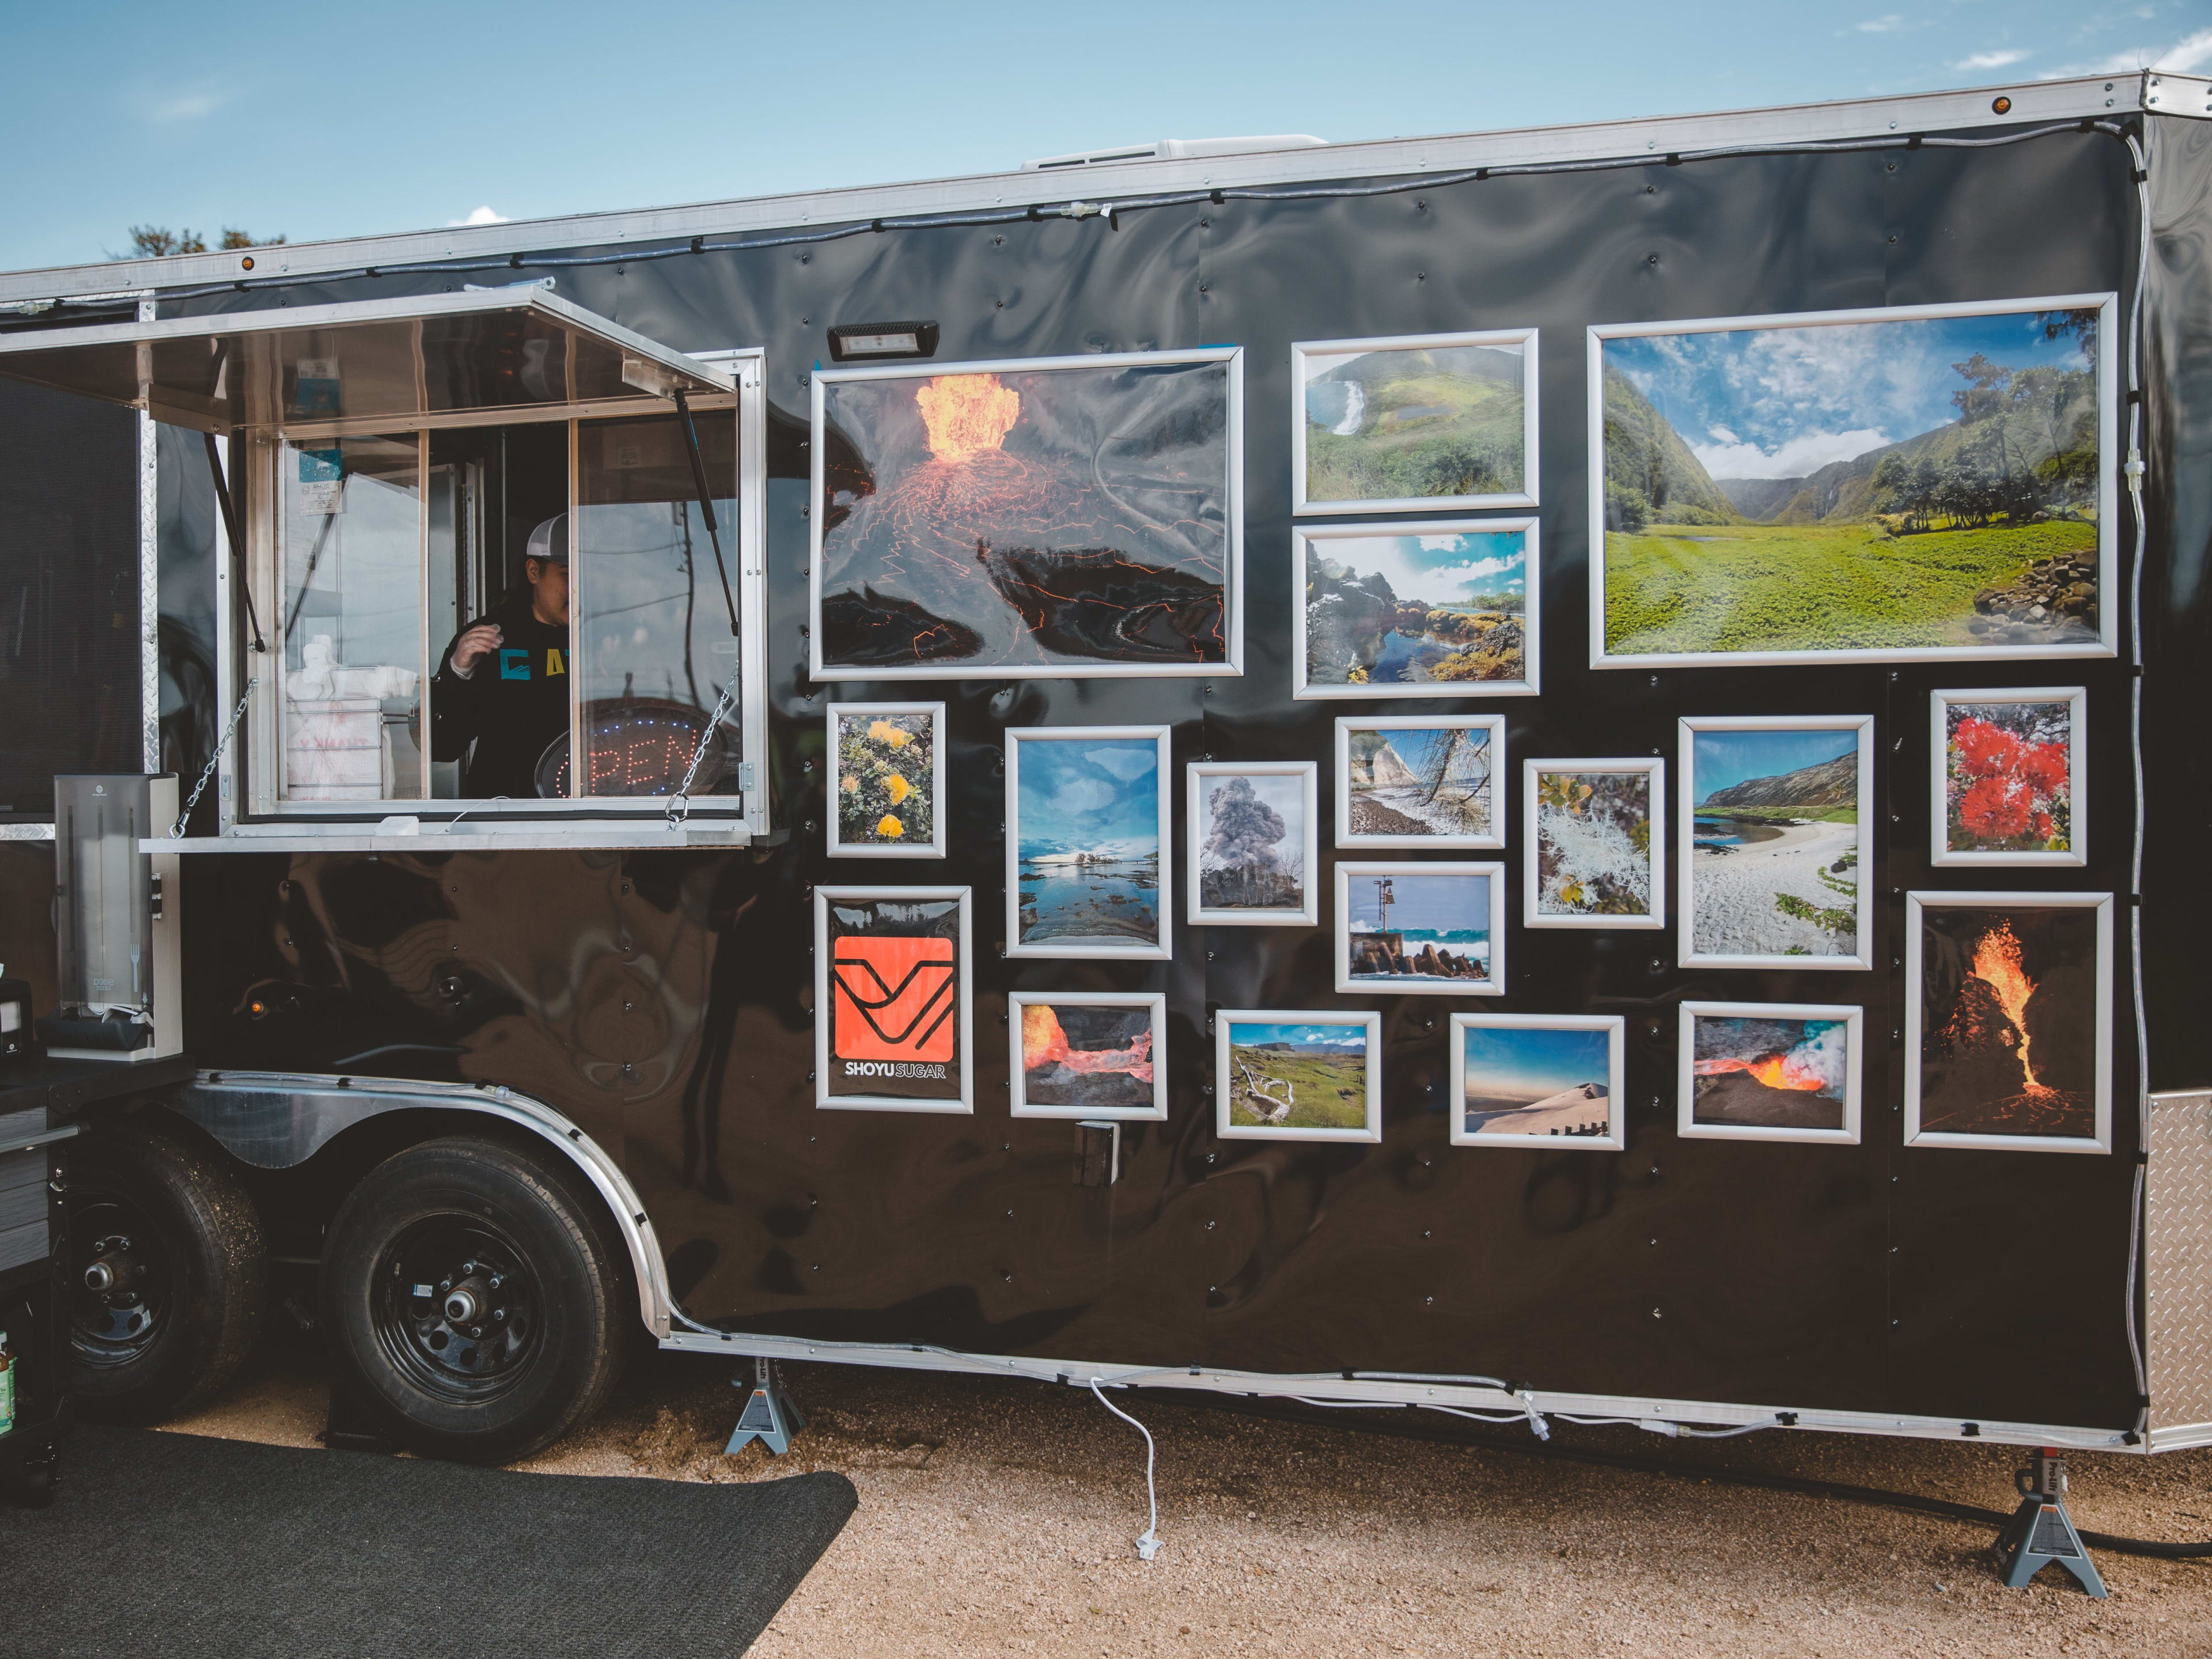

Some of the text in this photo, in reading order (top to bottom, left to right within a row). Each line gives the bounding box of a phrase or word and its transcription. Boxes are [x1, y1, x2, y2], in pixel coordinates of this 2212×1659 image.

[845, 1062, 946, 1079] SHOYU SUGAR
[2048, 1461, 2058, 1491] Pro-Lift
